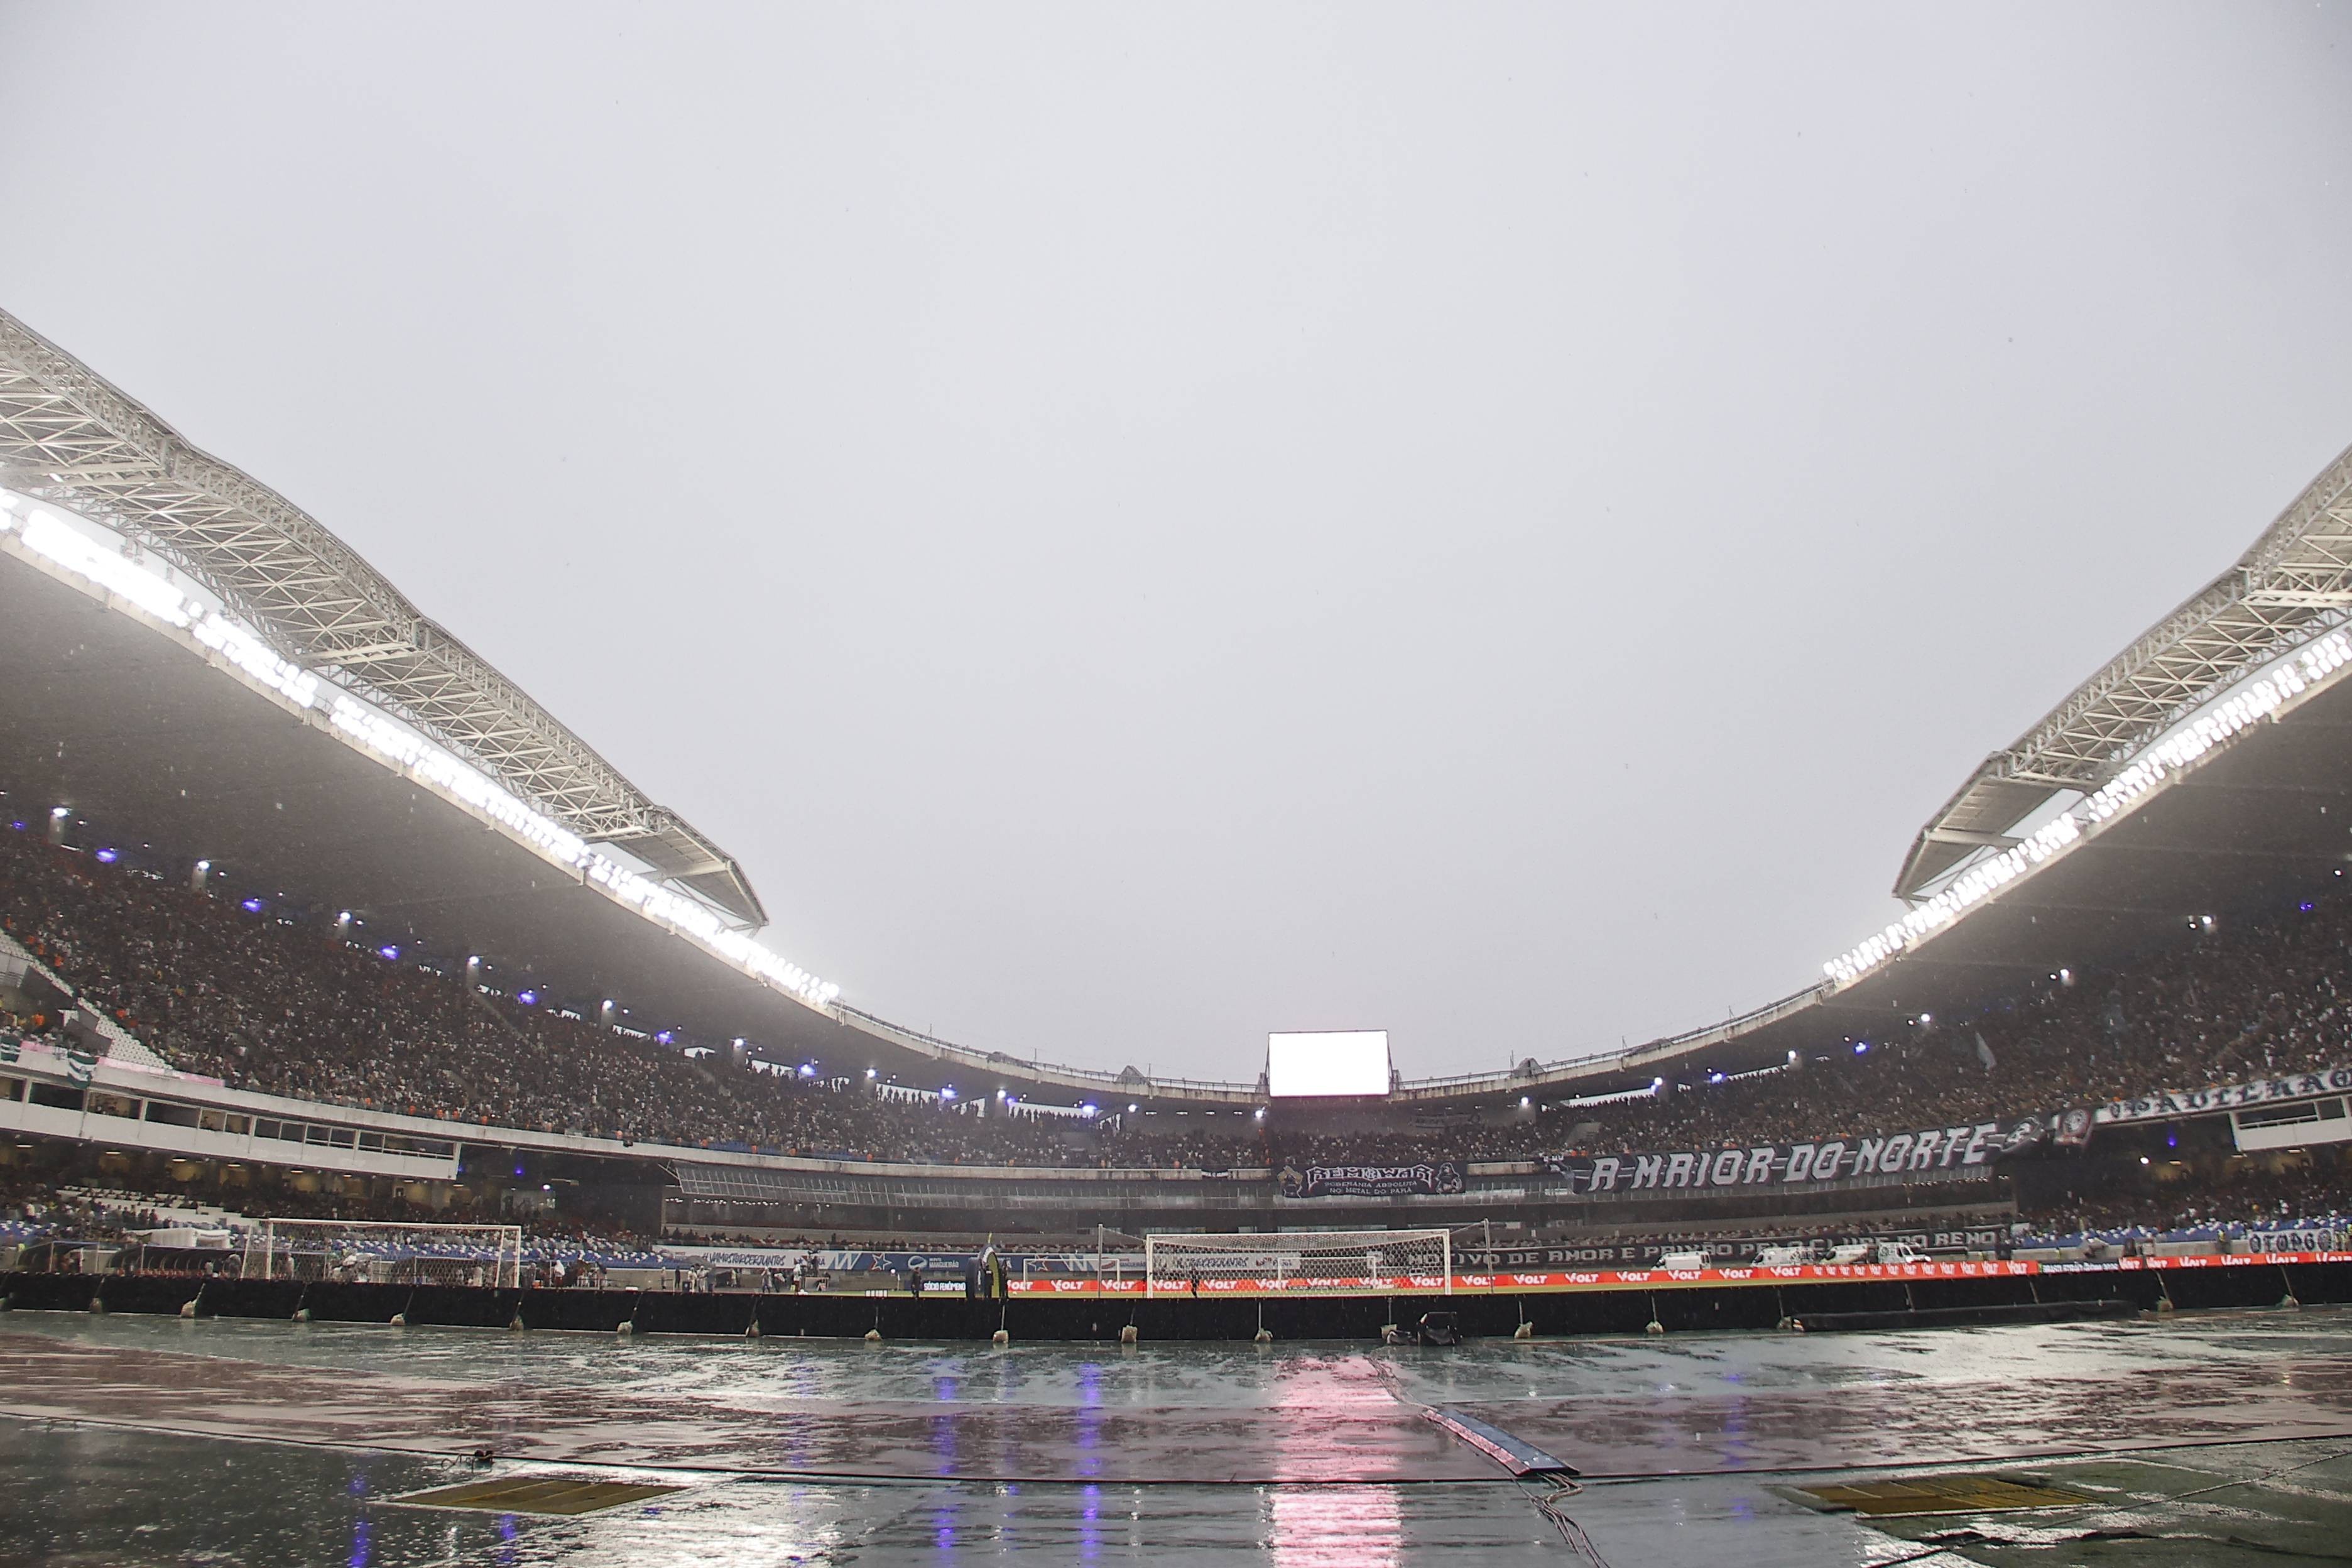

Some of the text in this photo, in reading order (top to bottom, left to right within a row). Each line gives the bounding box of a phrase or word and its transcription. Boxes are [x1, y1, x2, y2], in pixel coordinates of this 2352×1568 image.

[1588, 1122, 1996, 1191] A MAIOR DO NORTE
[1407, 1253, 1500, 1265] MOIVO
[1508, 1252, 1538, 1264] DE
[1548, 1248, 1614, 1263] AMOR
[1620, 1247, 1635, 1259] E
[1935, 1231, 1996, 1246] REMO
[1770, 1266, 1802, 1277] VOLT
[2006, 1260, 2027, 1275] VOLT
[1513, 1273, 1547, 1285] VOLT
[1565, 1272, 1599, 1283] VOLT
[1616, 1271, 1650, 1282] VOLT
[1668, 1270, 1702, 1280] VOLT
[1719, 1268, 1753, 1279] VOLT
[1051, 1279, 1084, 1290] VOLT
[1101, 1279, 1135, 1290] VOLT
[1153, 1279, 1186, 1289] VOLT
[1204, 1279, 1237, 1289] VOLT
[1255, 1278, 1288, 1290] VOLT
[1410, 1276, 1444, 1287] VOLT
